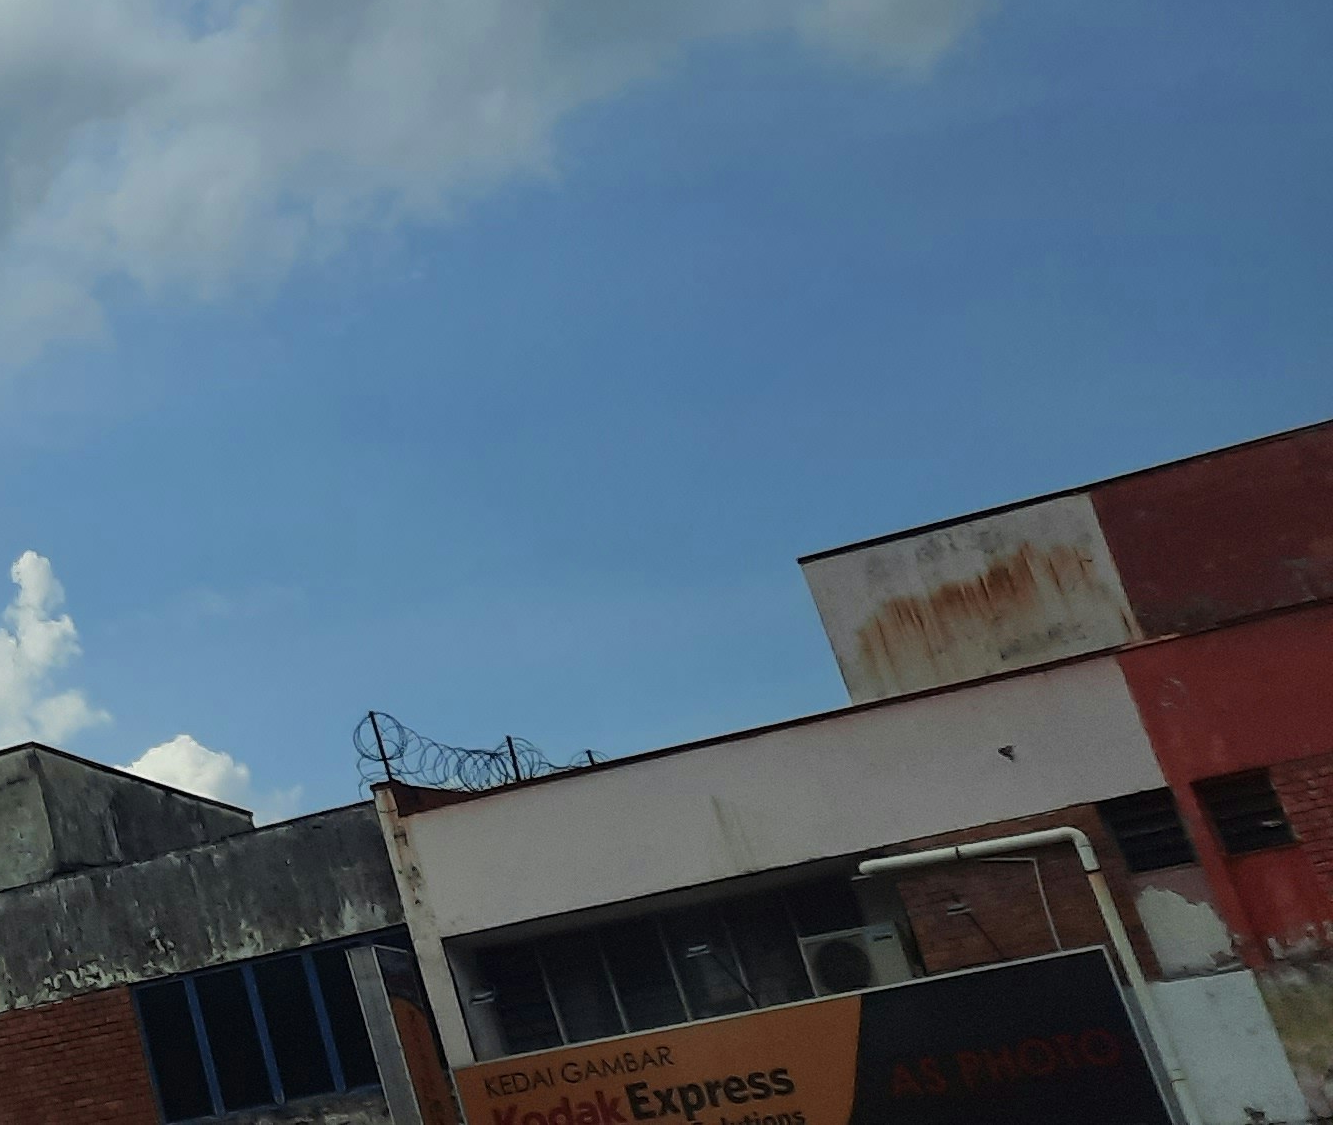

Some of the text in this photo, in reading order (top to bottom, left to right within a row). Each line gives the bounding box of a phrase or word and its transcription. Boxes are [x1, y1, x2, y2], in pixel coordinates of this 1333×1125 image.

[484, 1046, 675, 1100] KEDAI GAMBAR
[890, 1027, 1122, 1096] AS PHOTO
[625, 1068, 795, 1122] Express
